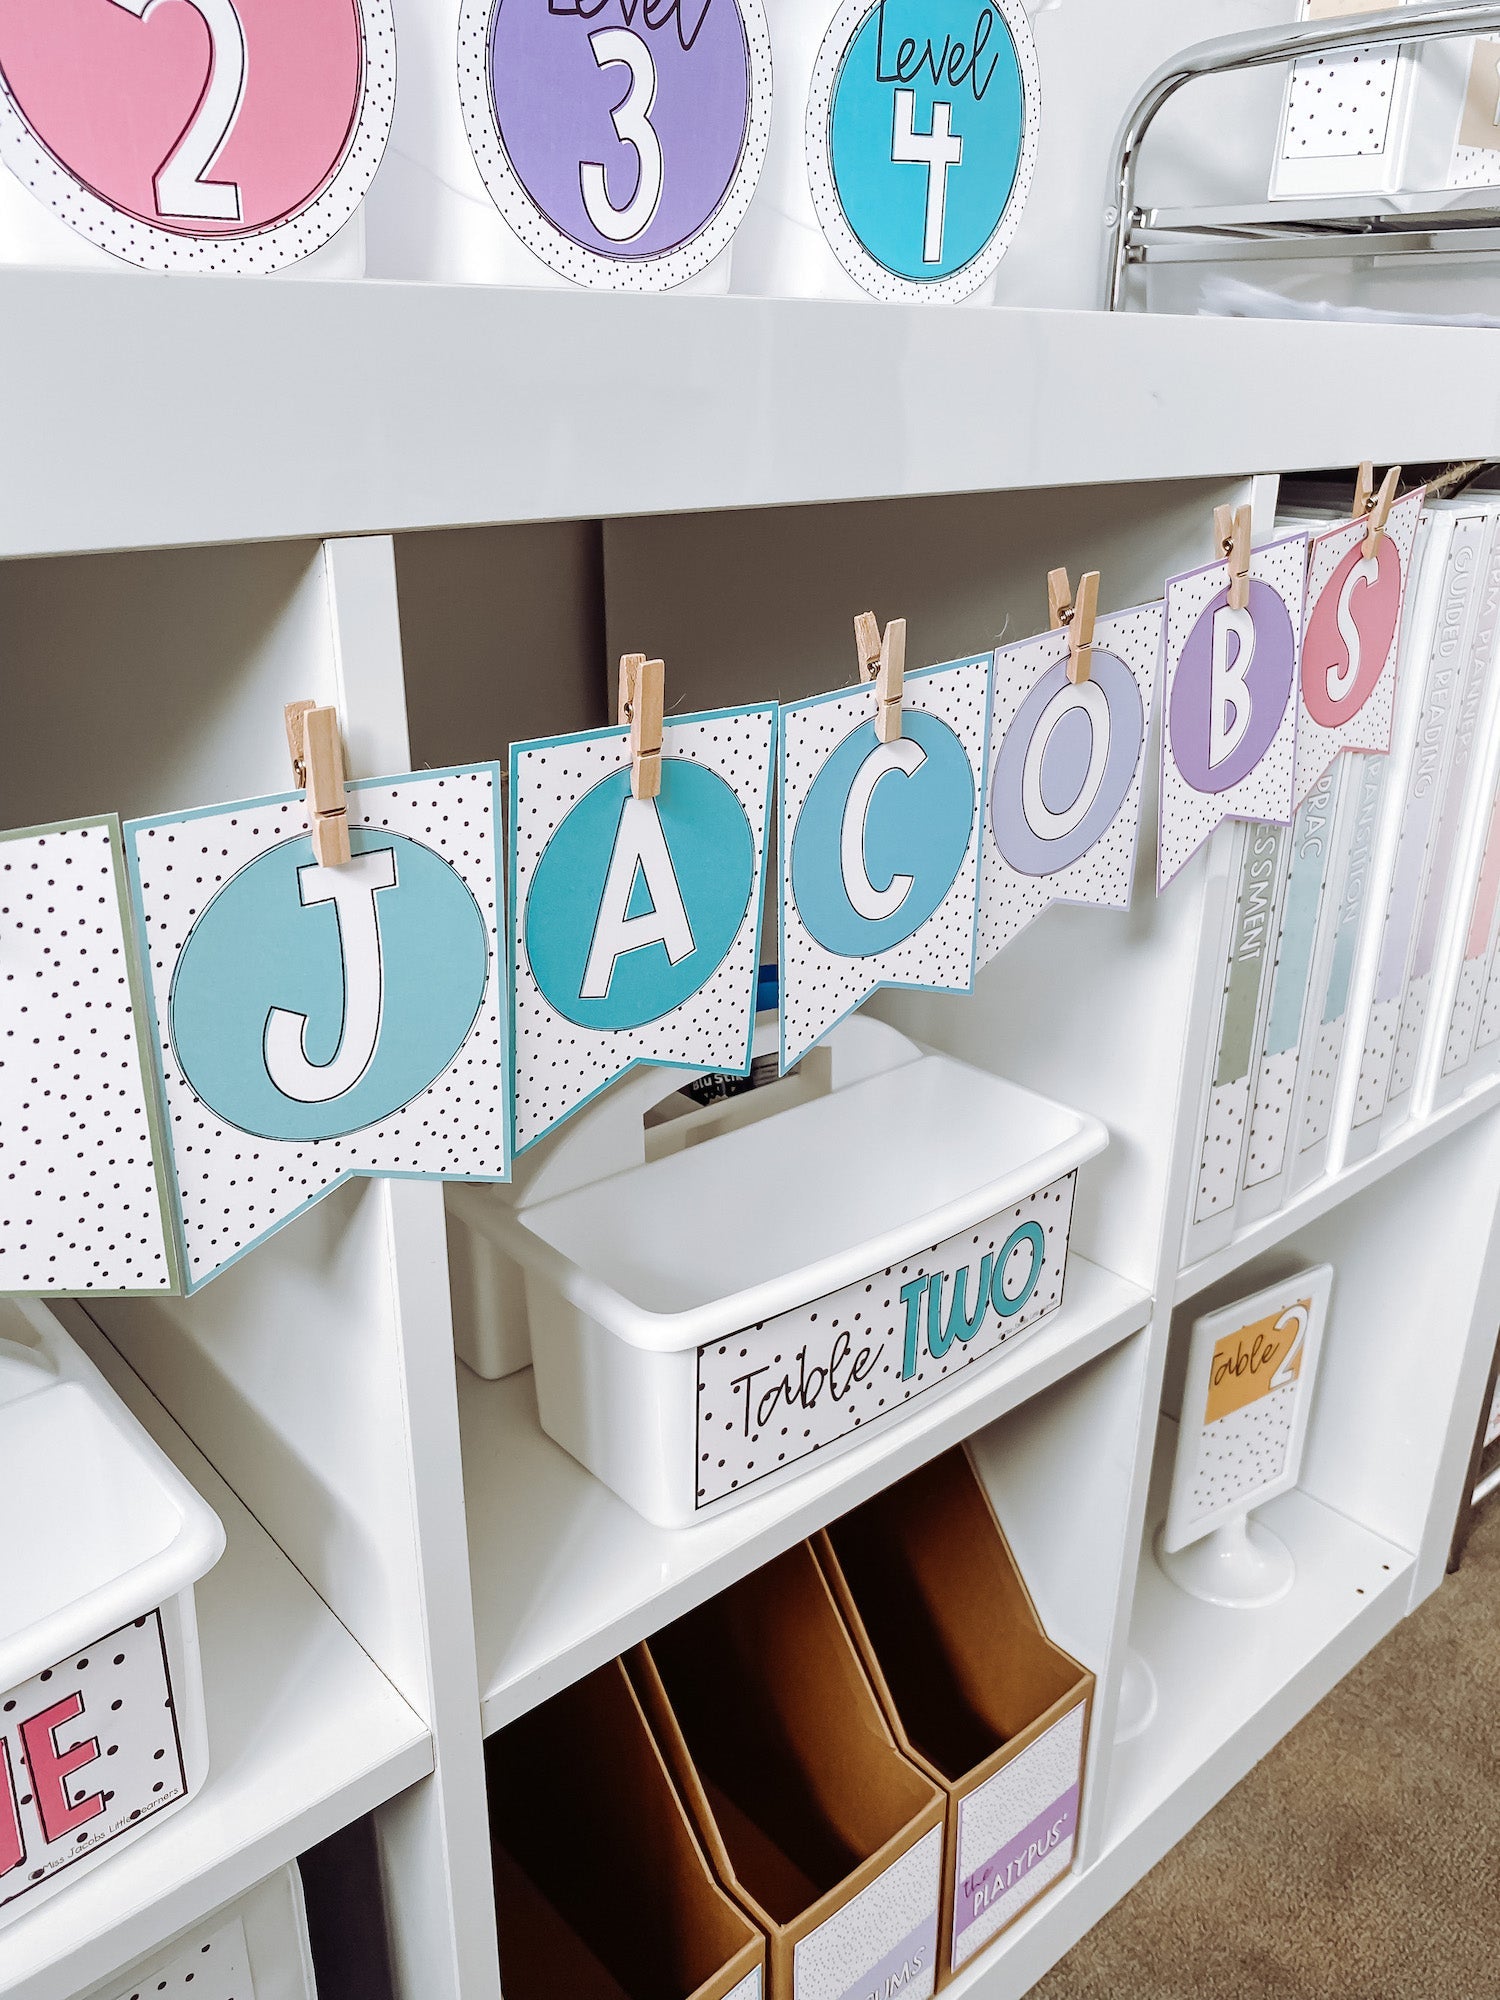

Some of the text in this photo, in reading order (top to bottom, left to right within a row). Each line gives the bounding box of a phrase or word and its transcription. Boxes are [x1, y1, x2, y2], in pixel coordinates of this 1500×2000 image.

[112, 0, 244, 222] 2
[578, 26, 665, 243] 3
[876, 0, 999, 101] Level
[891, 87, 963, 264] 4
[1414, 545, 1474, 799] GUIDED READING
[731, 1221, 1045, 1437] Table TWO
[1267, 1304, 1309, 1391] 2
[67, 1831, 106, 1858] Jacobs
[134, 1787, 179, 1818] earners
